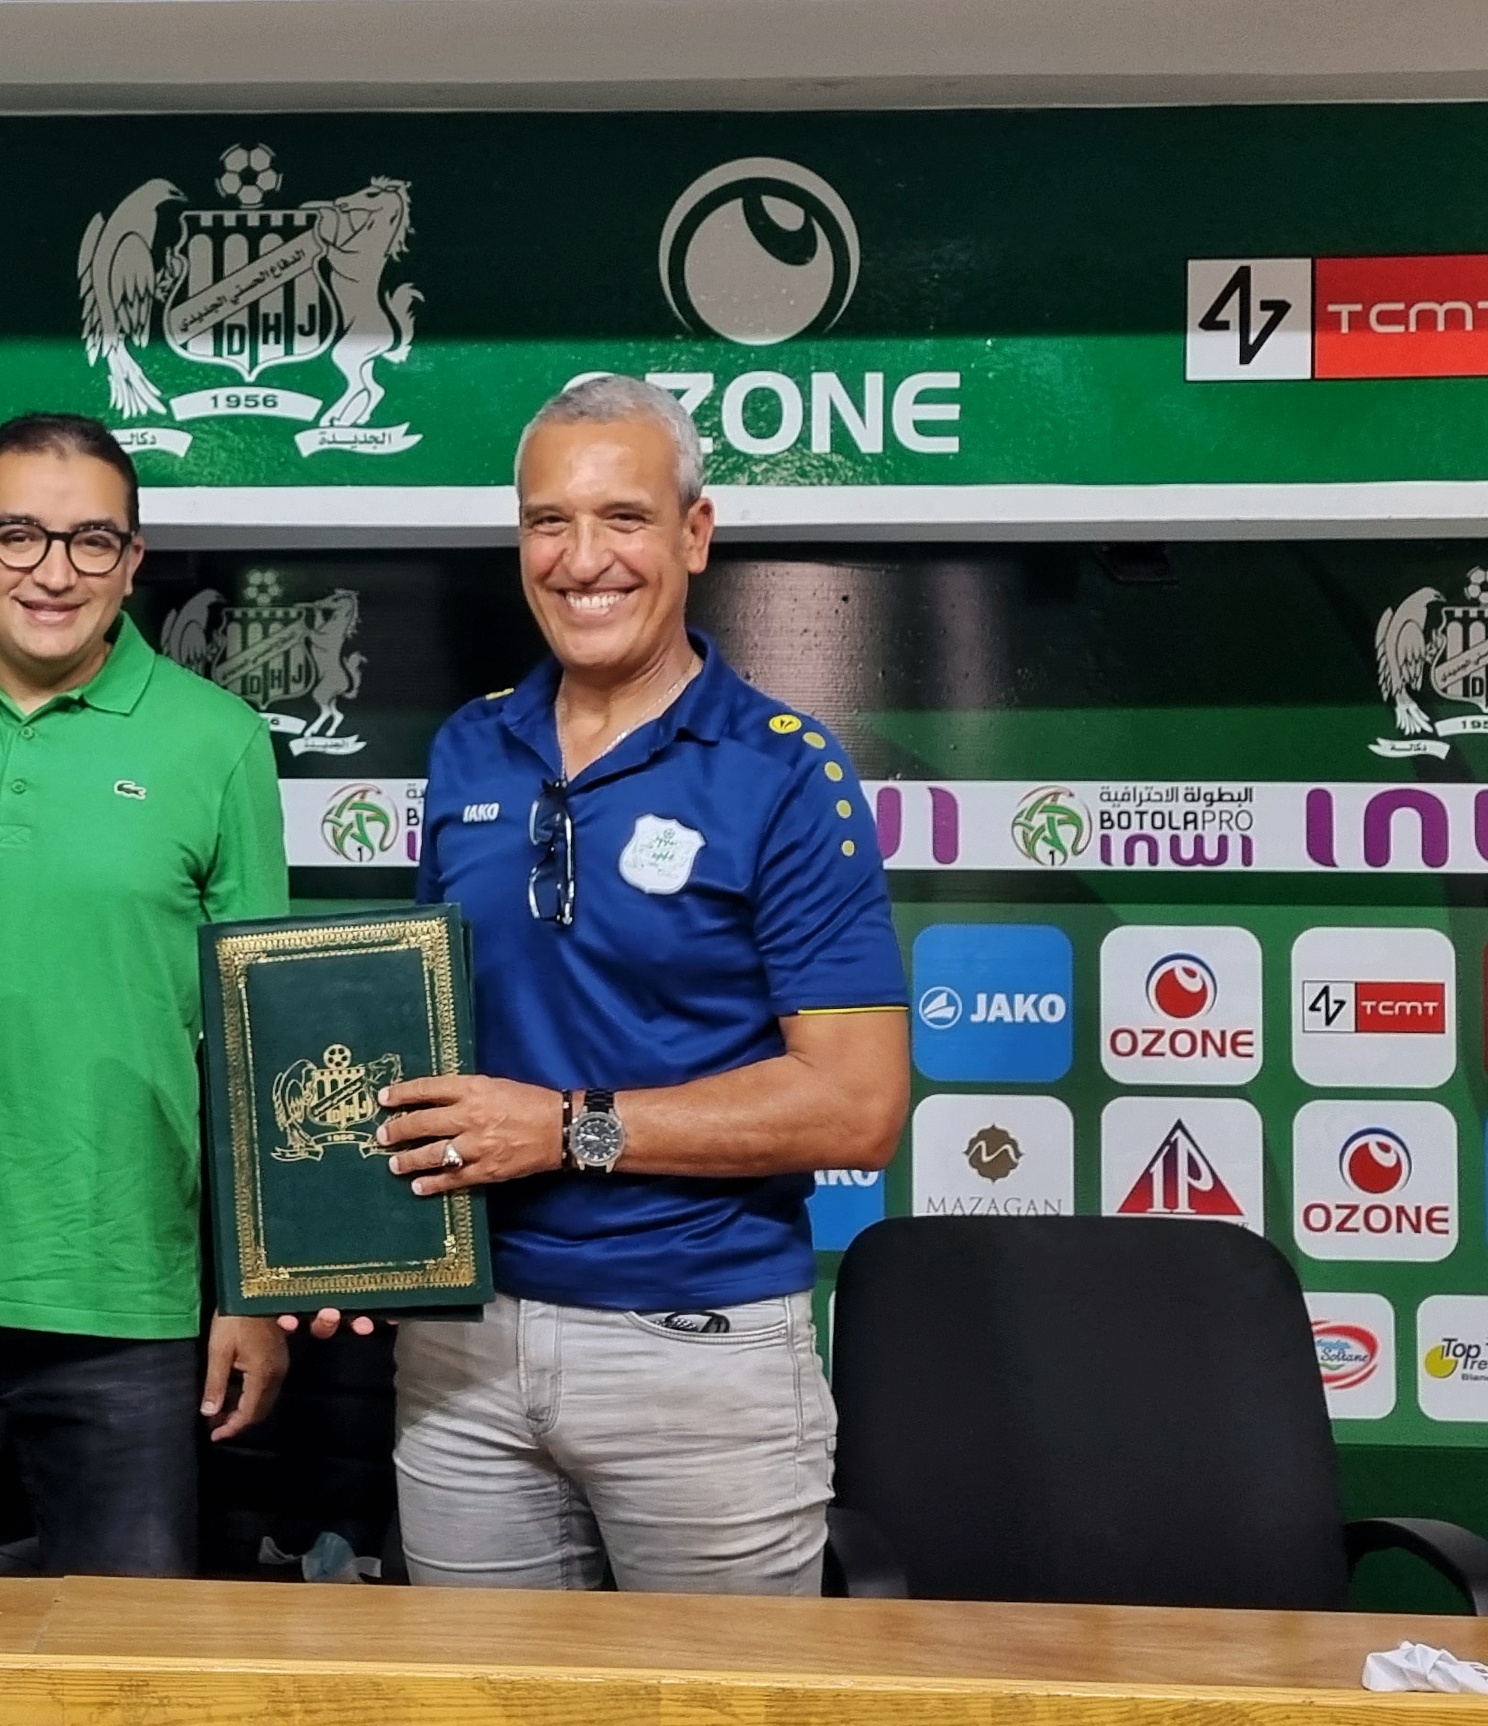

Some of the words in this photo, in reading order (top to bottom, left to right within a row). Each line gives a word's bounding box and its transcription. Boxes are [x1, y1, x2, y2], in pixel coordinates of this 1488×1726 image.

[1327, 301, 1488, 334] TCM
[211, 394, 279, 409] 1956
[562, 370, 961, 455] ZONE
[1099, 786, 1180, 808] الاحترافية
[1184, 786, 1254, 808] البطولة
[1306, 788, 1488, 868] in
[970, 993, 1066, 1023] JAKO
[1361, 1000, 1440, 1016] TCMT
[1109, 1028, 1255, 1058] OZONE
[926, 1196, 1062, 1216] MAZAGAN
[1303, 1203, 1450, 1235] OZONE
[1442, 1338, 1481, 1369] Top
